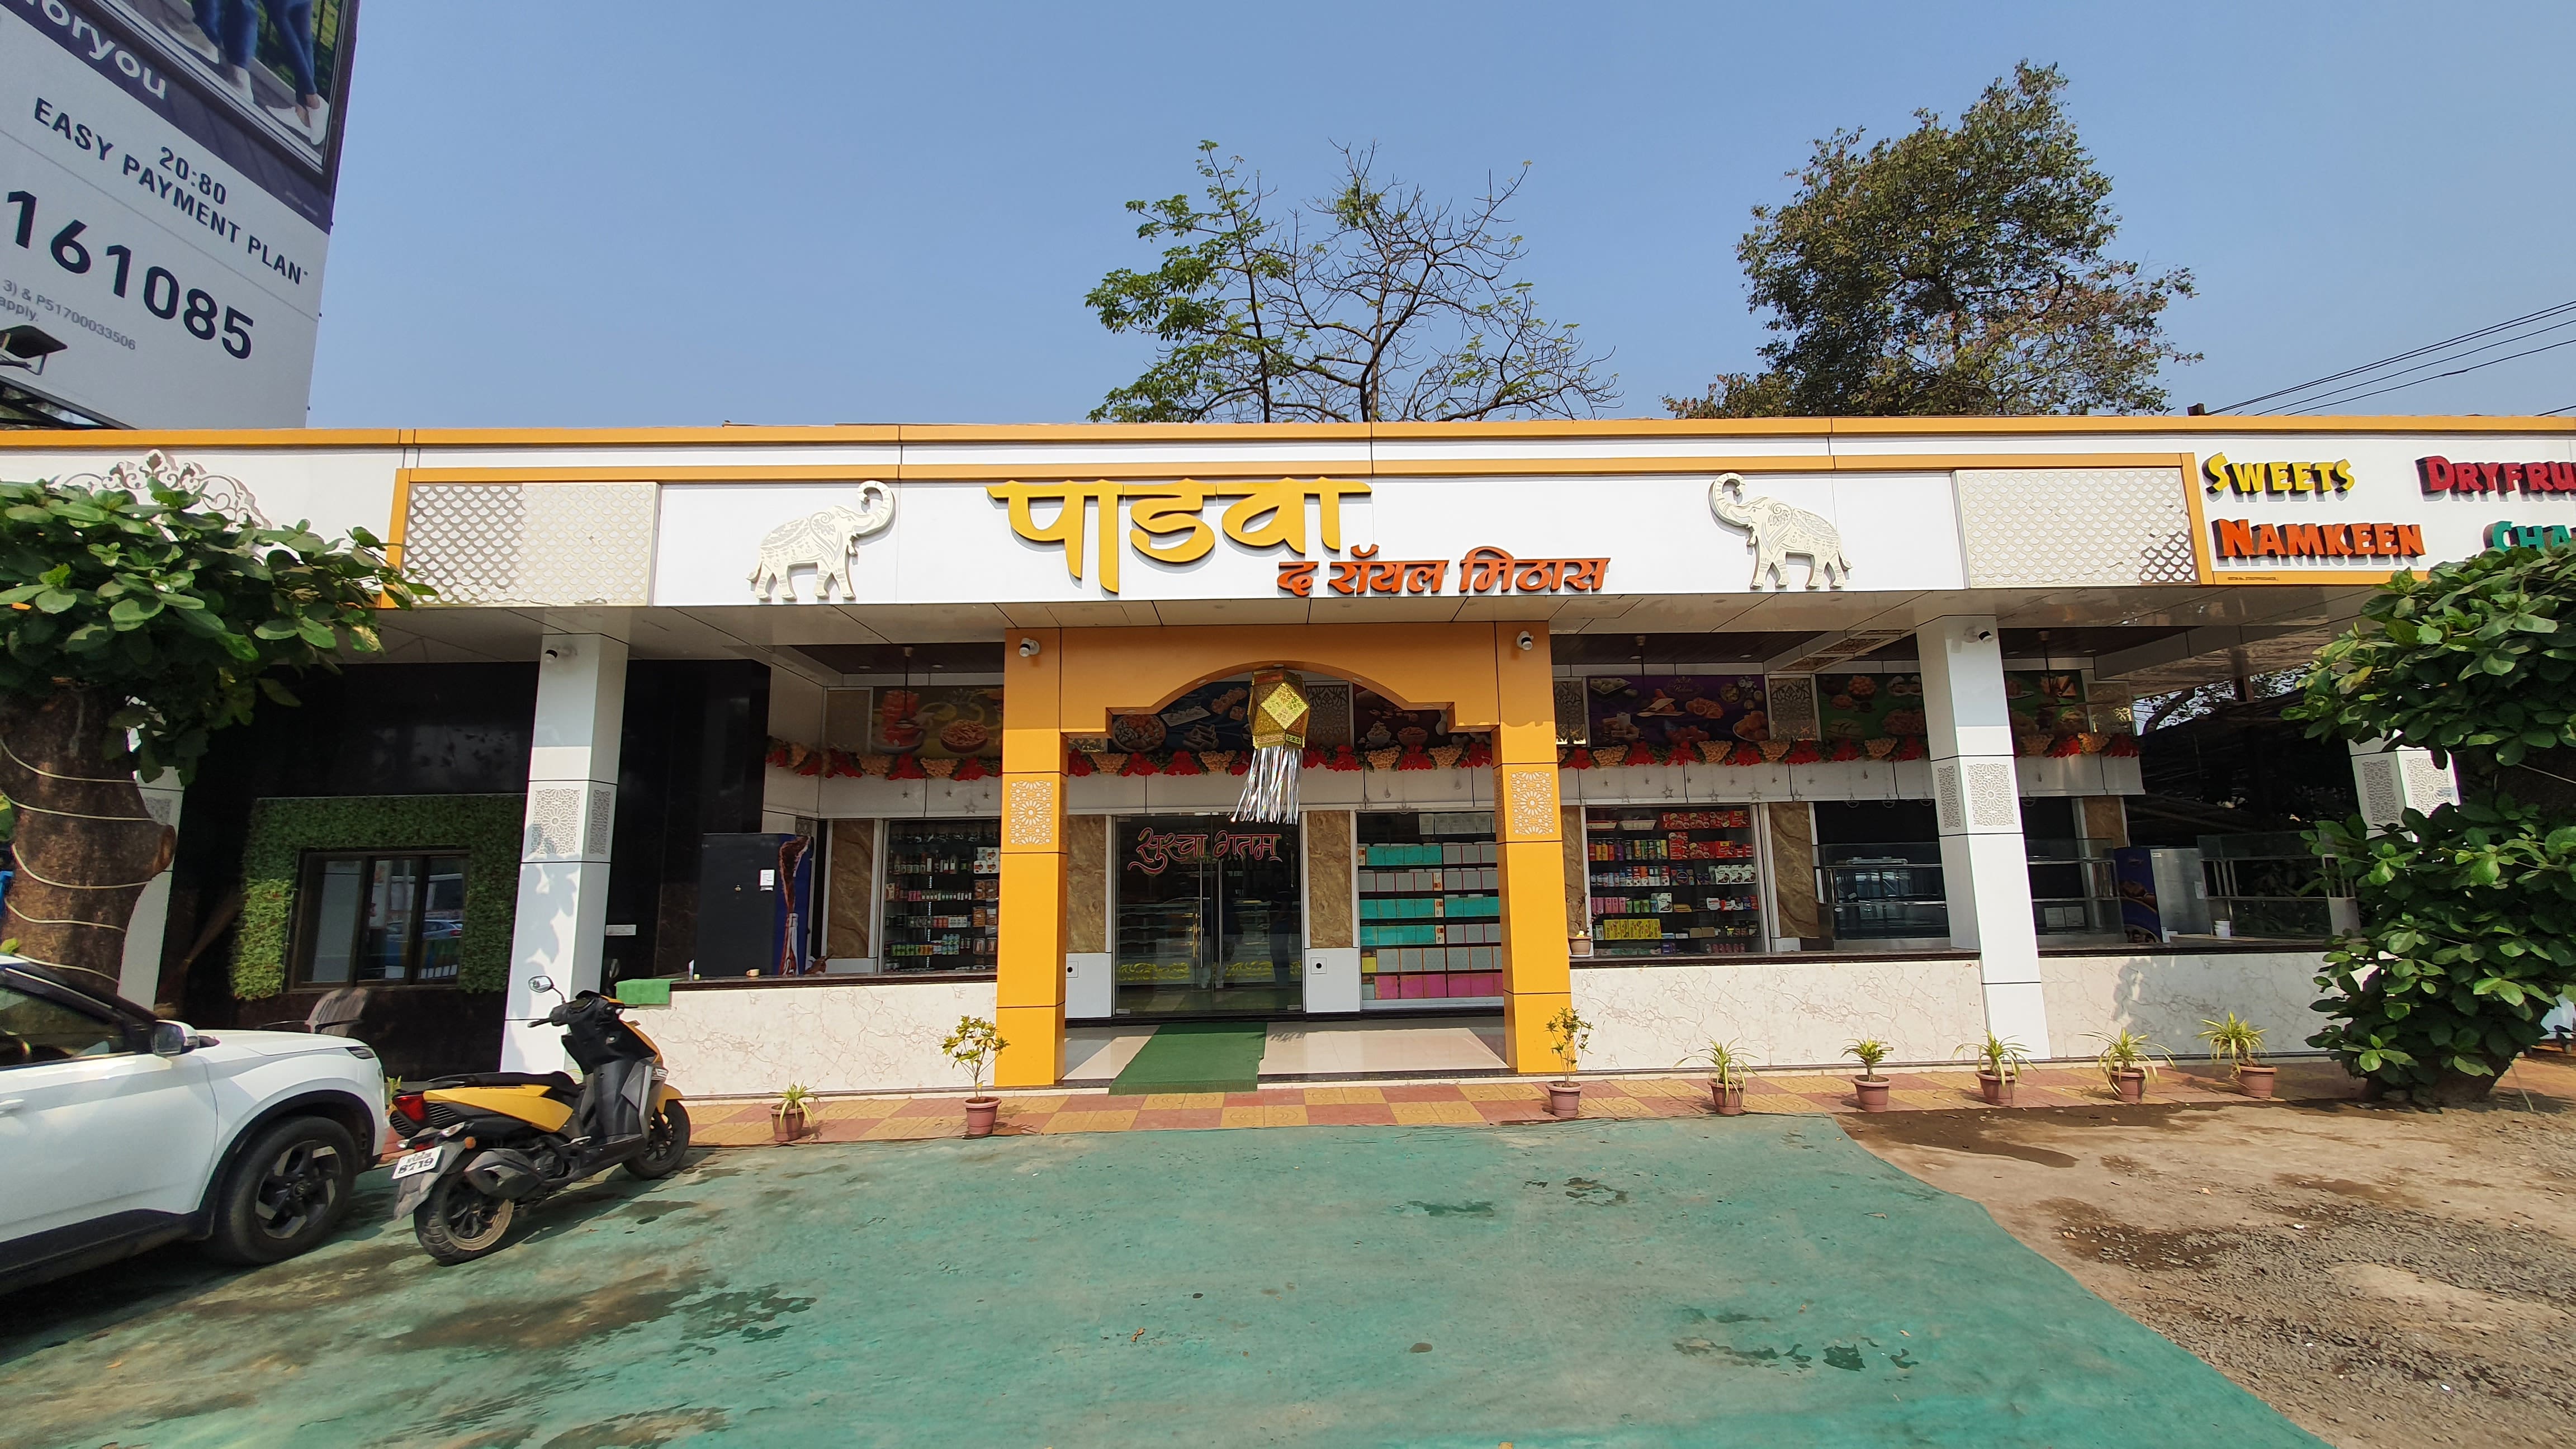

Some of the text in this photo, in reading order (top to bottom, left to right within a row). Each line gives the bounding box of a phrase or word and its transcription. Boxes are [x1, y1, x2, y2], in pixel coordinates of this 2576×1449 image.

[26, 0, 166, 100] oryou
[34, 97, 113, 161] EASY
[122, 154, 241, 244] PAYMENT
[160, 146, 226, 205] 20:80
[7, 190, 254, 359] 161085
[0, 296, 39, 322] apply.
[21, 288, 32, 302] &
[36, 295, 136, 351] P51700033506
[2202, 452, 2576, 494] SWEETS DRYFRU
[985, 477, 1372, 594] पाडवा
[2212, 519, 2576, 558] NAMKEEN CHA
[1277, 544, 1611, 598] द रॉयल मिठास
